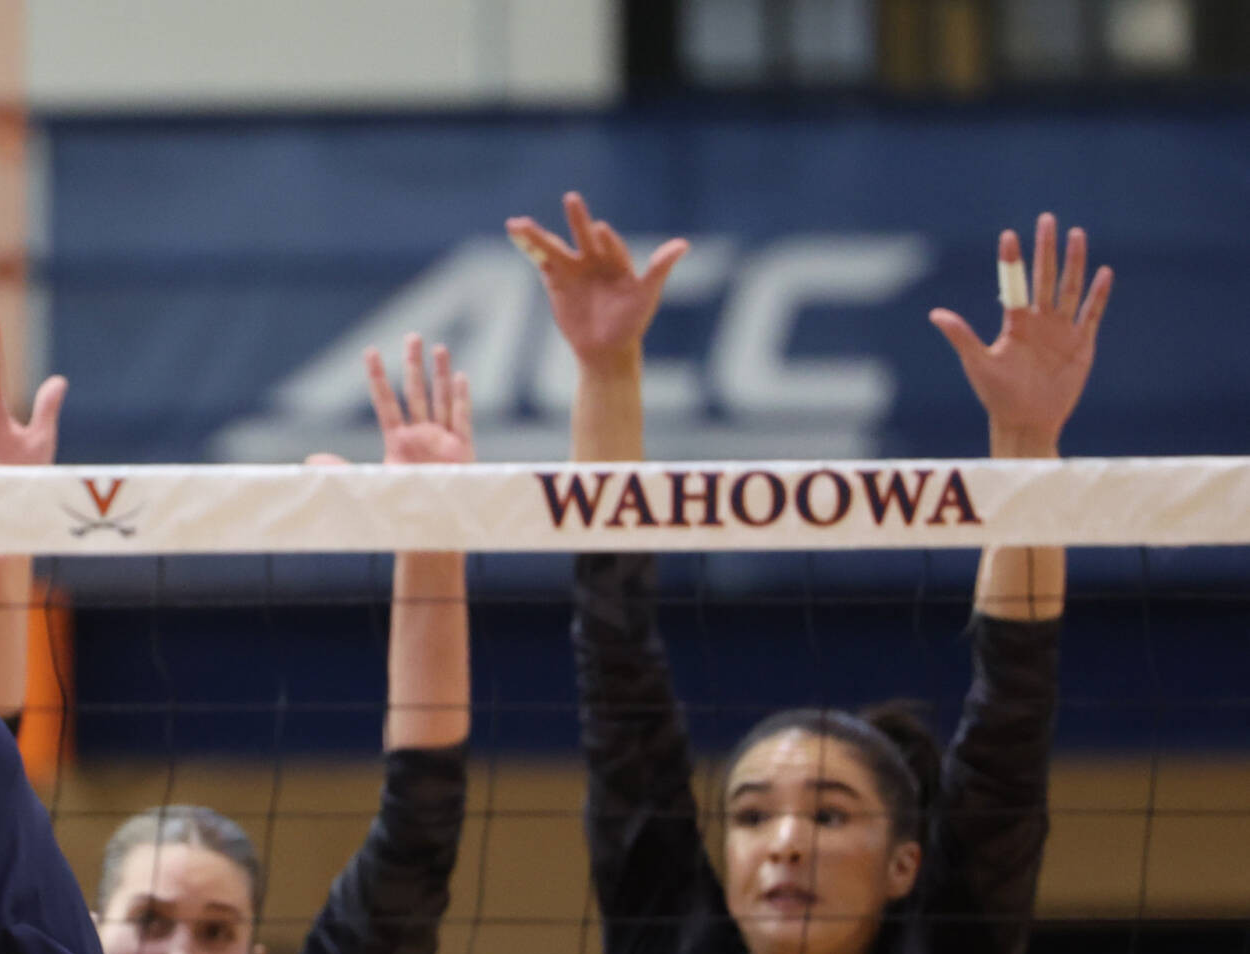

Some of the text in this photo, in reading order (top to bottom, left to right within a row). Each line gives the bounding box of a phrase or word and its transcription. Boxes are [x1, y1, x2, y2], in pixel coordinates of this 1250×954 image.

[270, 232, 928, 416] ACC
[86, 477, 126, 519] V
[538, 470, 983, 530] WAHOOWA
